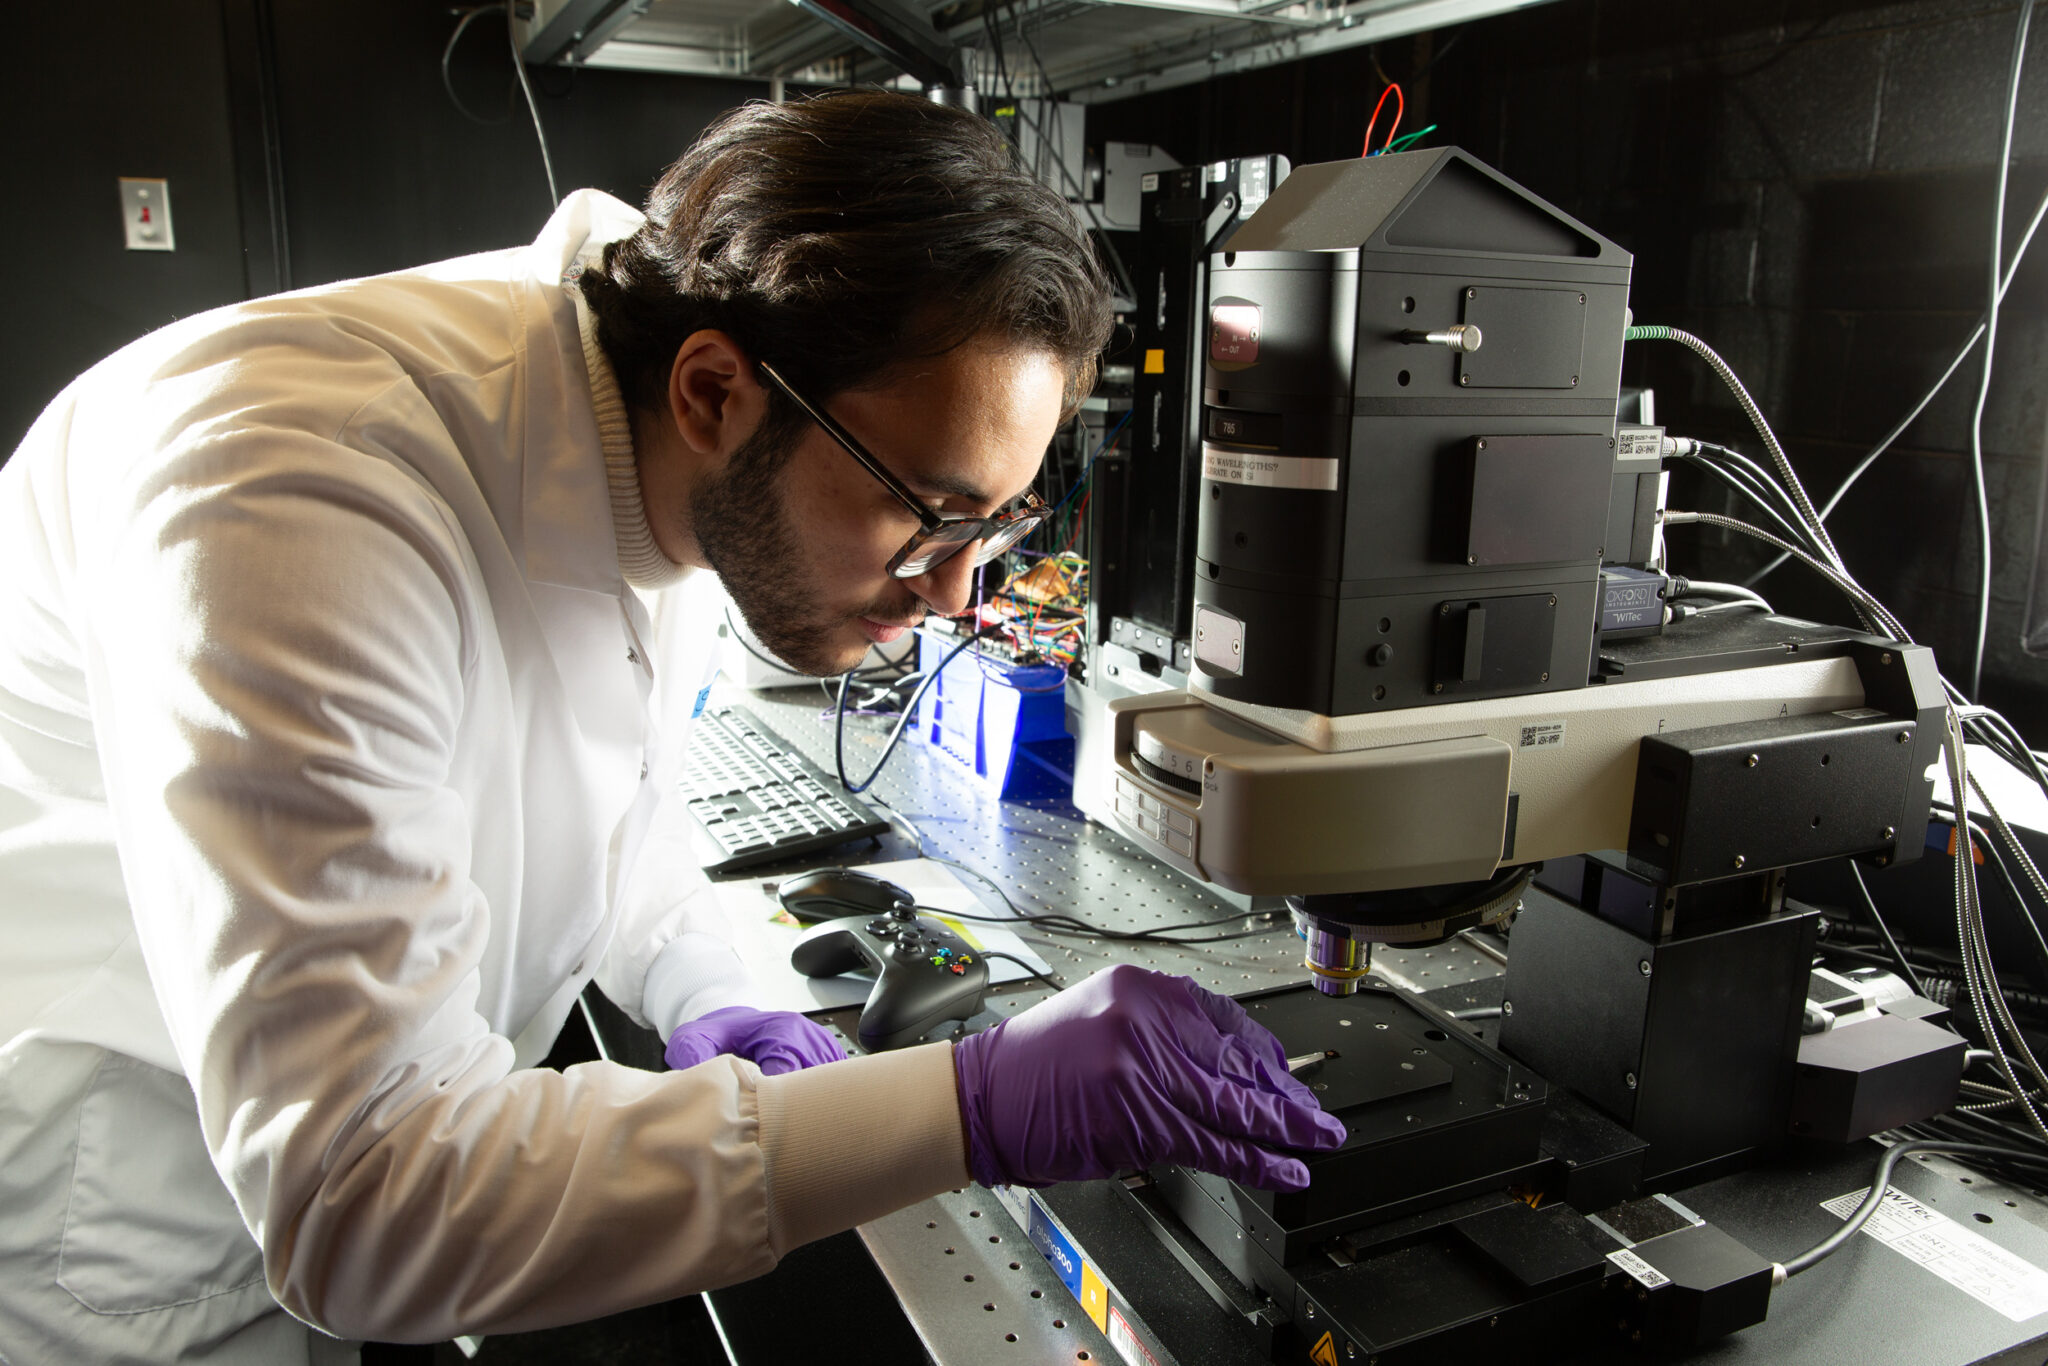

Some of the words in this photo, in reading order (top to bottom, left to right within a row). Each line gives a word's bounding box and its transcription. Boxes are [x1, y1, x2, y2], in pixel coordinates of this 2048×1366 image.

[1229, 345, 1240, 354] OUT
[1223, 422, 1236, 434] 785
[1217, 457, 1280, 473] WAVELENGTHS?
[1230, 470, 1242, 479] ON
[1606, 588, 1648, 603] OXFORD
[1605, 600, 1646, 608] INSTRUMENTS
[1779, 703, 1788, 718] A
[1657, 719, 1666, 736] F
[1171, 756, 1177, 767] 5
[1185, 760, 1193, 773] 6
[1918, 1232, 1947, 1250] SN:
[1036, 1225, 1073, 1274] alpha300
[1090, 1289, 1097, 1305] R
